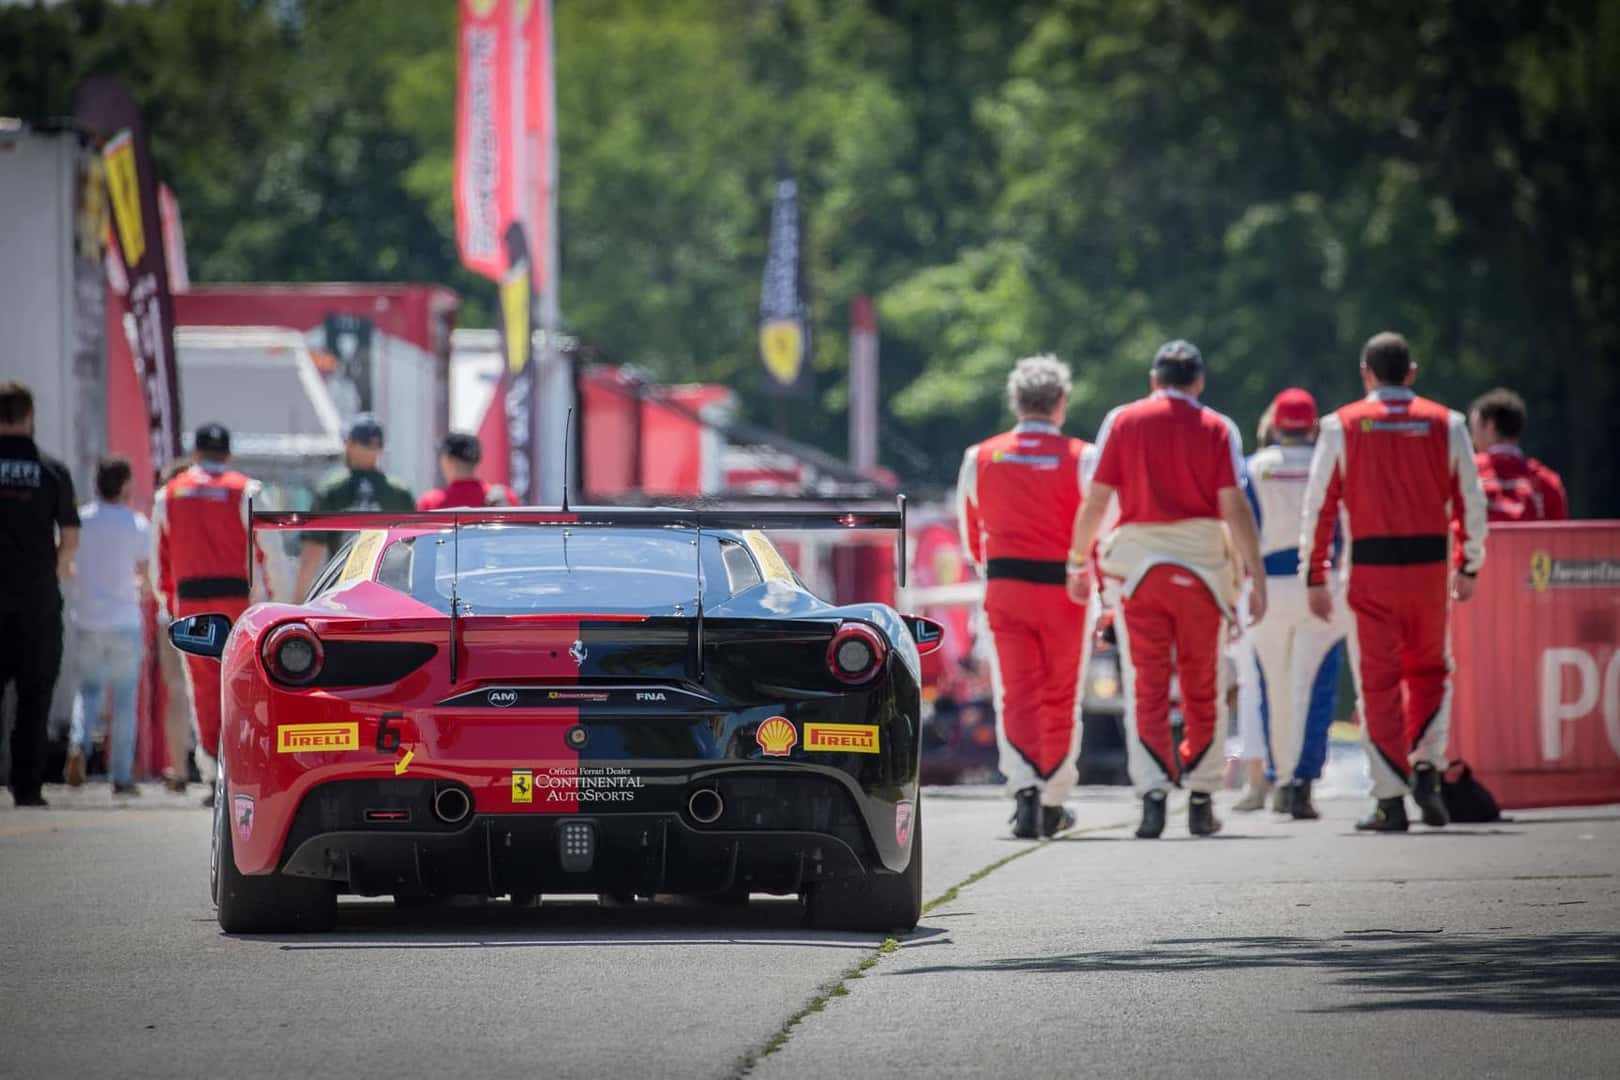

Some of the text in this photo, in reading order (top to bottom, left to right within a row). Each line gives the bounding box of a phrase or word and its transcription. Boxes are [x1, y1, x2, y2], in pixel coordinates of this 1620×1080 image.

[490, 692, 515, 701] AM
[636, 692, 666, 701] FNA
[284, 728, 351, 747] PIRELLI
[376, 711, 404, 753] 6
[810, 728, 873, 748] PIRELLI
[549, 767, 632, 775] Official Ferrari Dealer
[535, 774, 645, 788] CONTINENTAL
